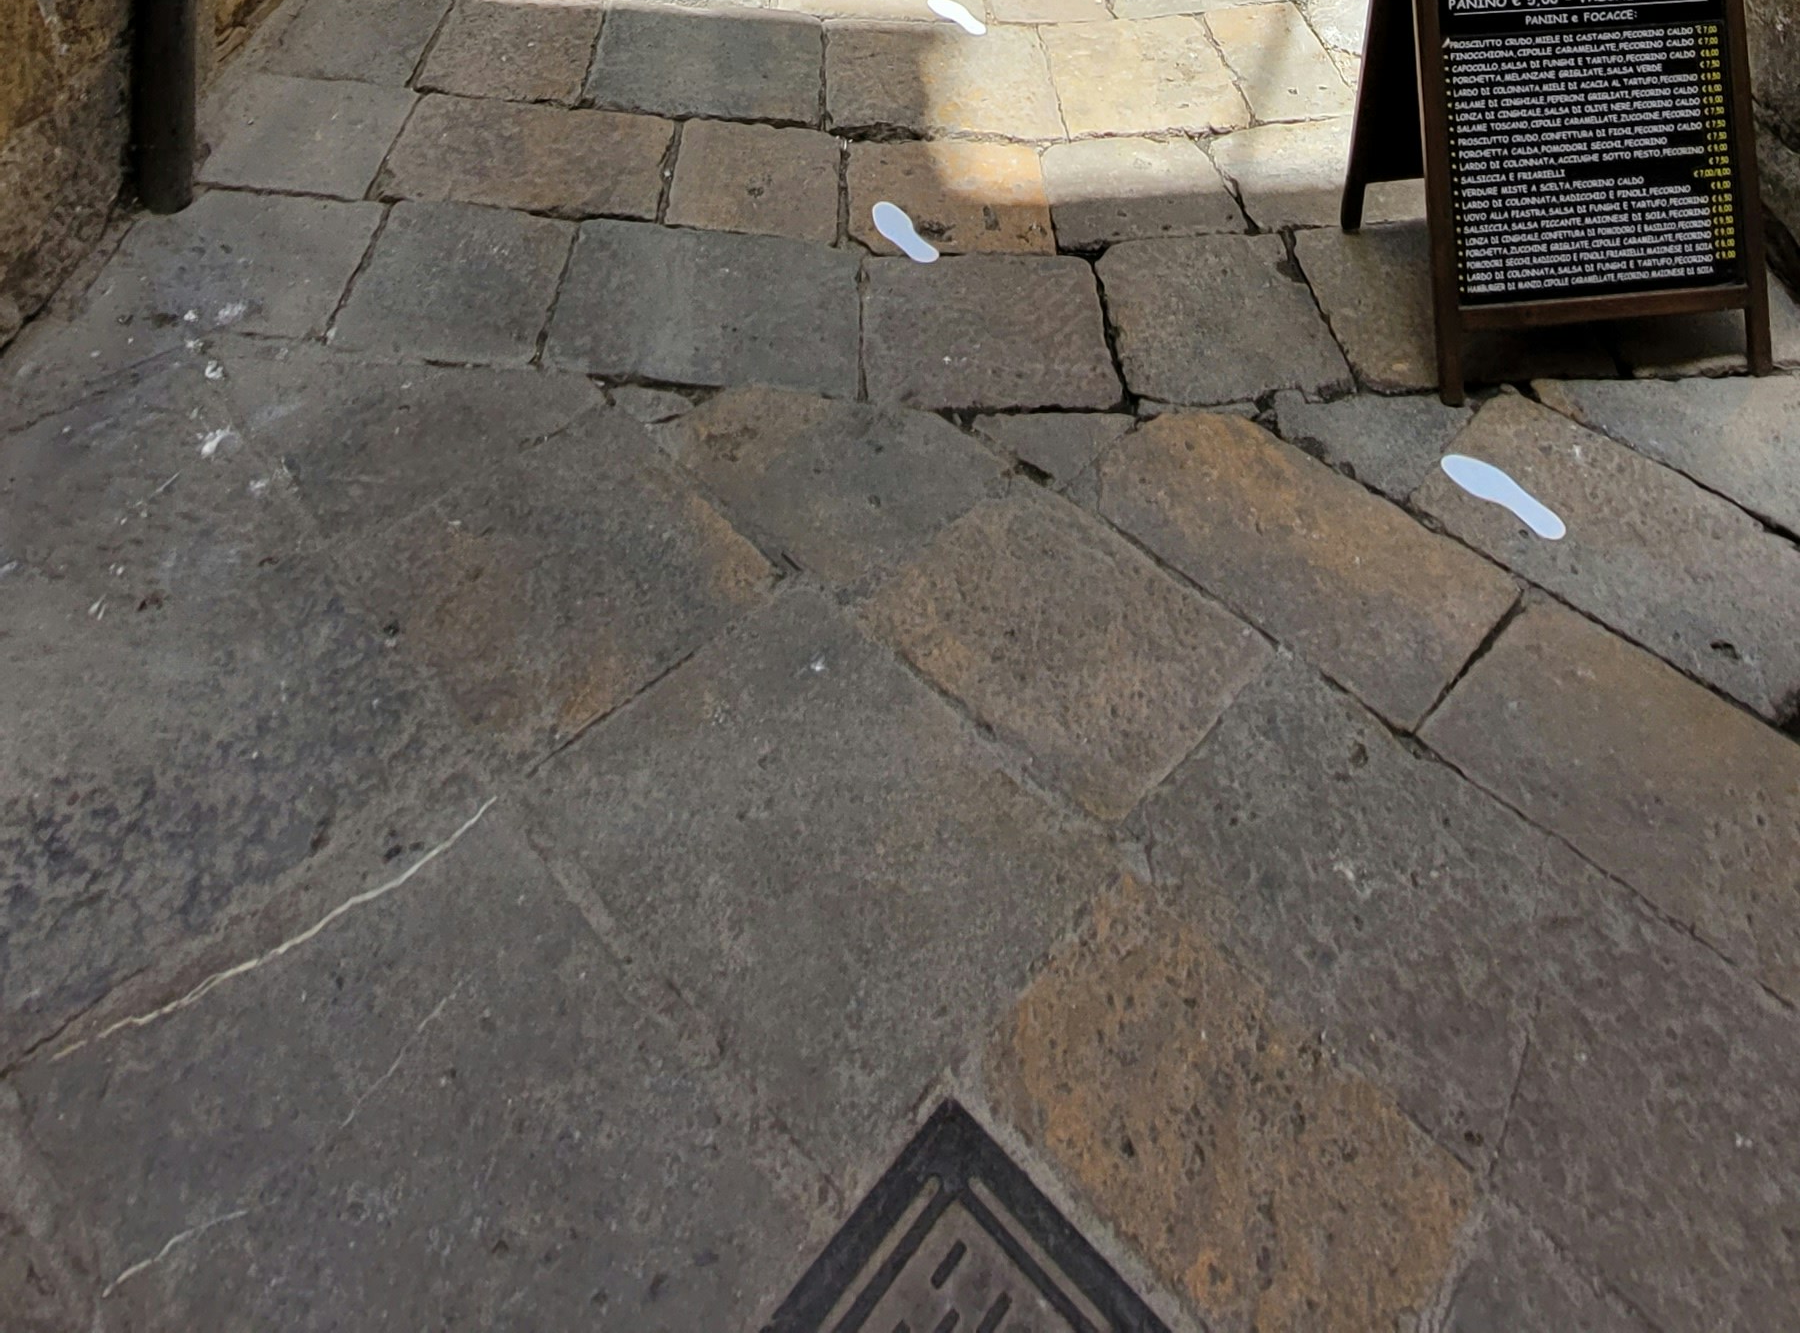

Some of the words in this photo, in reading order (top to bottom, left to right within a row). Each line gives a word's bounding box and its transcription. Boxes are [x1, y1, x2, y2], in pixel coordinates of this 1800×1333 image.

[1525, 13, 1569, 25] PANINI
[1571, 14, 1578, 22] e
[1583, 9, 1638, 22] FOCACCE:
[1448, 39, 1502, 49] PROSCIUTTO
[1563, 34, 1574, 43] DI
[1667, 27, 1694, 36] CALDO
[1666, 38, 1694, 47] CALDO
[1530, 60, 1540, 69] DI
[1542, 58, 1575, 67] FUNGHI
[1577, 57, 1583, 66] E
[1669, 50, 1696, 59] CALDO
[1636, 63, 1662, 73] VERDE
[1453, 88, 1479, 98] LARDO
[1480, 87, 1490, 96] DI
[1568, 81, 1578, 90] DI
[1580, 80, 1609, 89] ACACIA
[1611, 79, 1621, 87] AL
[1454, 99, 1486, 110] SALAME
[1488, 99, 1498, 108] DI
[1673, 85, 1699, 95] CALDO
[1455, 112, 1483, 122] LONZA
[1485, 111, 1495, 120] DI
[1571, 105, 1582, 114] DI
[1584, 103, 1608, 113] OLIVE
[1675, 97, 1700, 107] CALDO
[1457, 123, 1487, 133] SALAME
[1458, 135, 1509, 146] PROSCIUTTO
[1596, 129, 1606, 138] DI
[1676, 121, 1702, 131] CALDO
[1459, 148, 1508, 159] PORCHETTA
[1459, 161, 1487, 171] LARDO
[1489, 160, 1500, 169] DI
[1602, 151, 1632, 161] SOTTO
[1461, 174, 1506, 185] SALSICCIA
[1509, 172, 1514, 181] E
[1517, 169, 1565, 180] FRIARIELLI
[1461, 186, 1498, 197] VERDURE
[1501, 184, 1528, 194] MISTE
[1531, 184, 1537, 192] A
[1617, 176, 1644, 186] CALDO
[1462, 200, 1490, 210] LARDO
[1492, 199, 1502, 208] DI
[1609, 190, 1614, 199] E
[1463, 212, 1487, 222] UOVO
[1490, 211, 1509, 220] ALLA
[1576, 205, 1587, 214] DI
[1589, 202, 1621, 212] FUNGHI
[1622, 201, 1628, 210] E
[1631, 212, 1642, 221] DI
